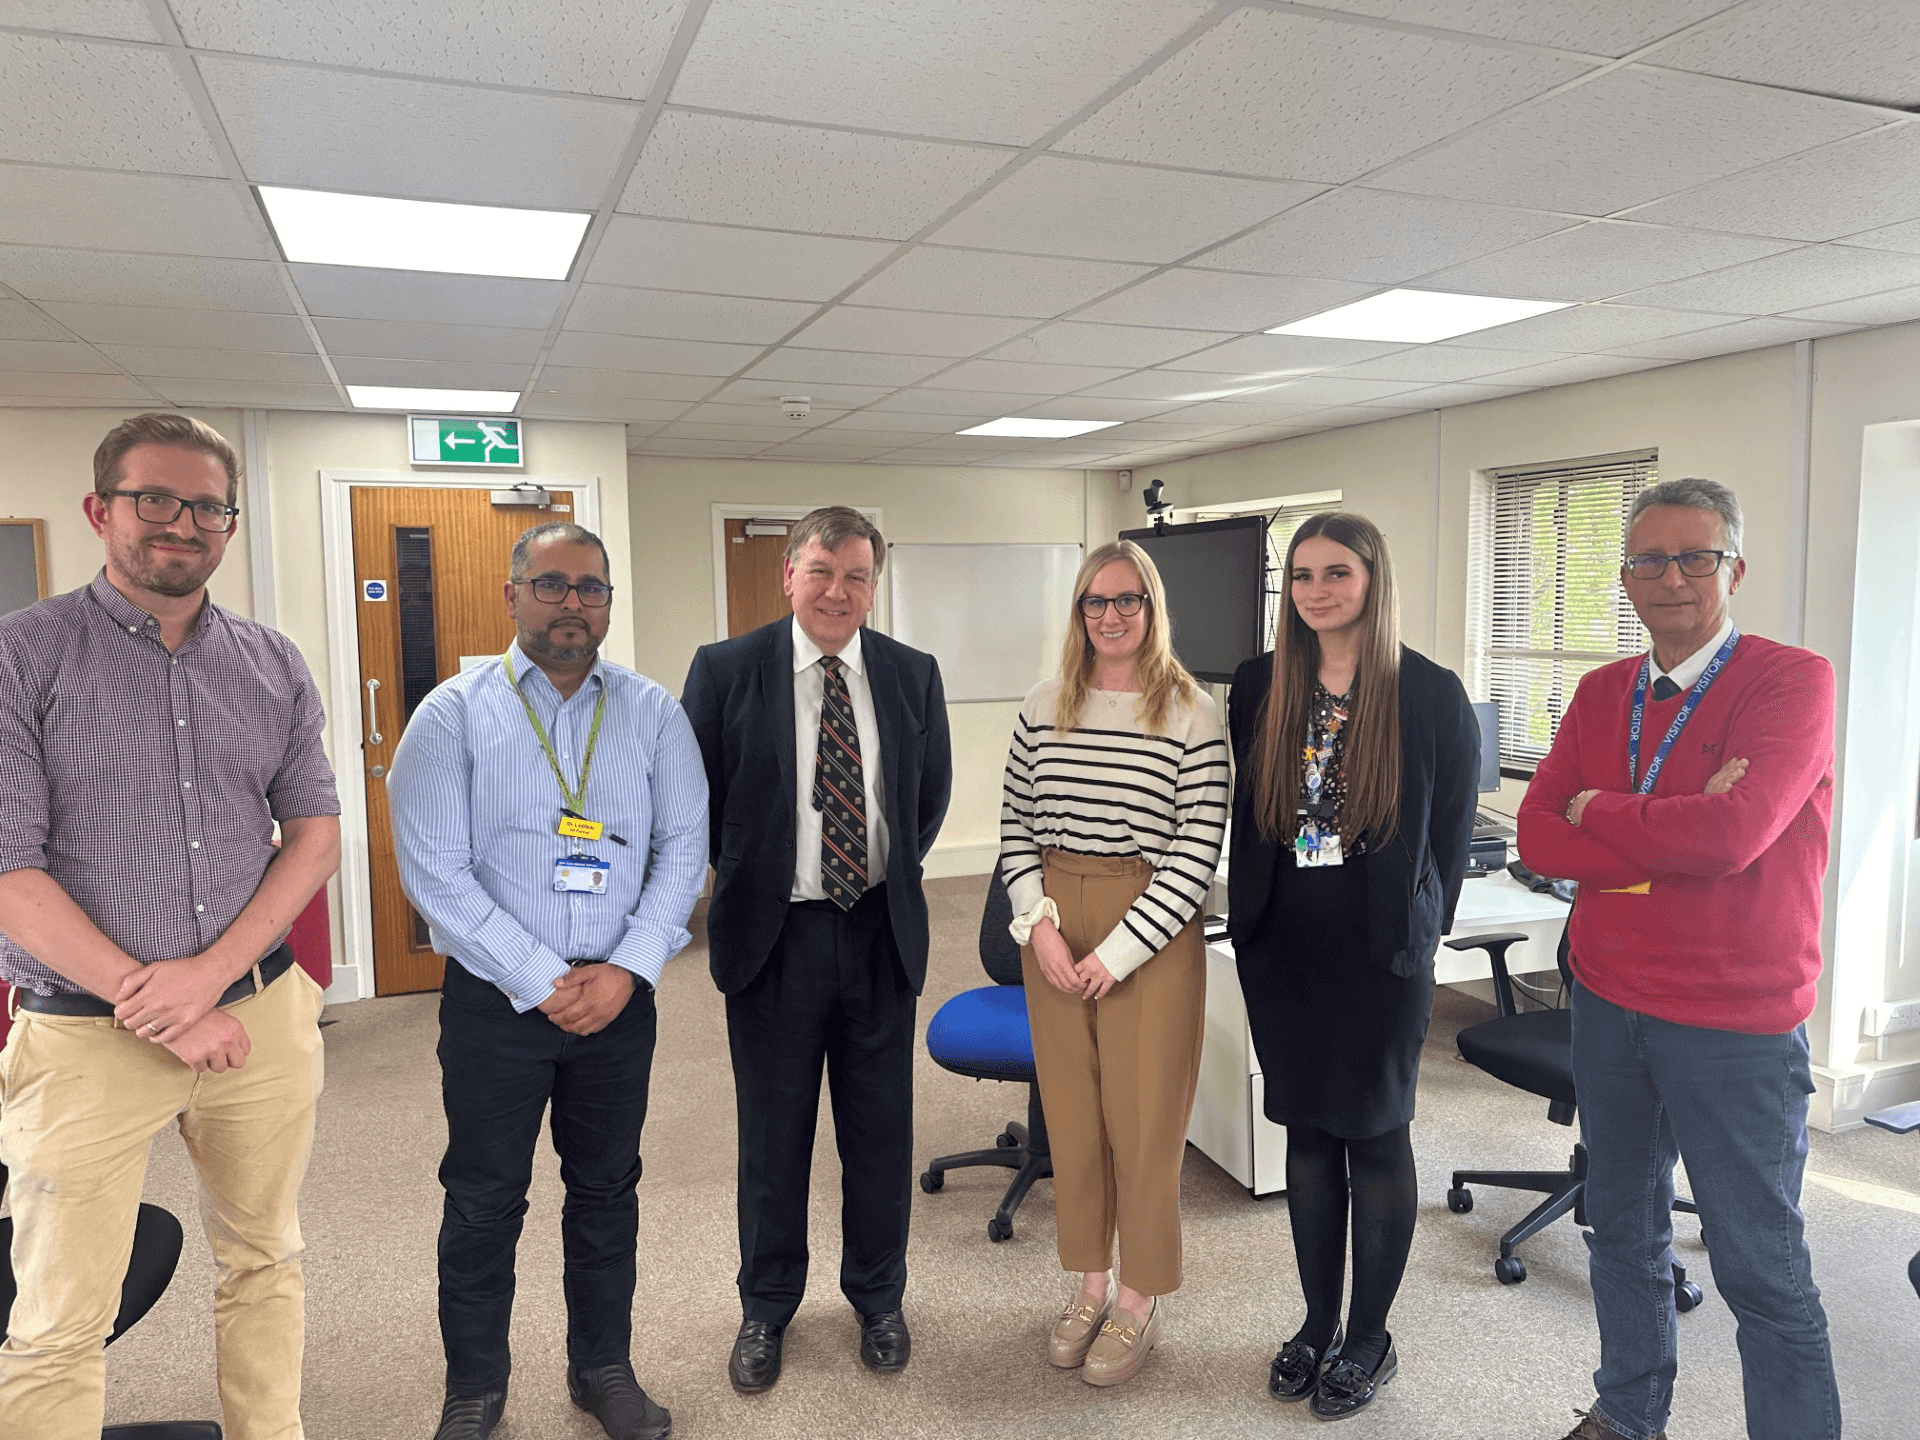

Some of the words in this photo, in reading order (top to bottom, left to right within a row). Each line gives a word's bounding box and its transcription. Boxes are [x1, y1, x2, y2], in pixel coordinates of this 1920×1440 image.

[1692, 657, 1724, 693] VISITOR
[1630, 703, 1643, 741] VISITOR
[1663, 705, 1692, 744] VISITOR
[1638, 756, 1663, 794] VISITOR
